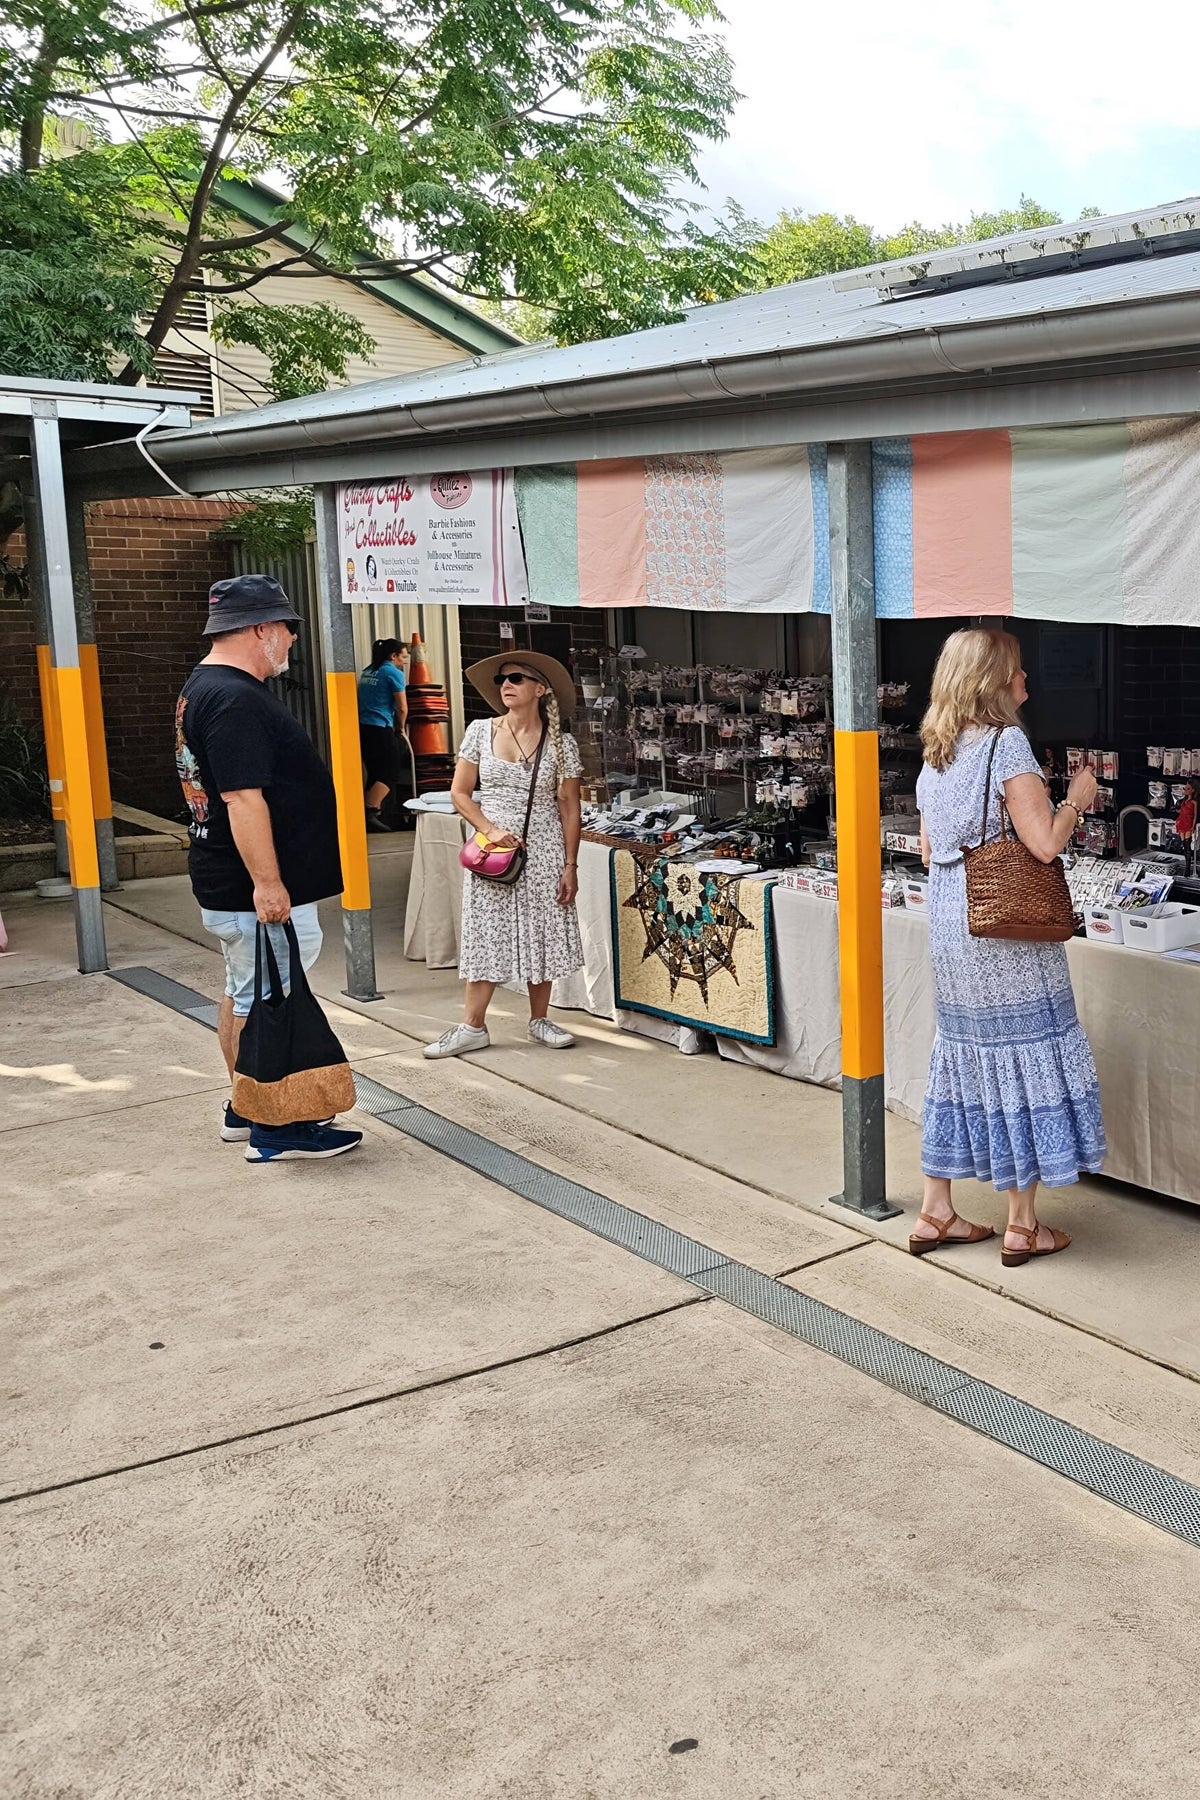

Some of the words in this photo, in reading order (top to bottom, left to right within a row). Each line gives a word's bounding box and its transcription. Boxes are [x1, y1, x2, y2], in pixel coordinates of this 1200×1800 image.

[344, 480, 375, 517] Quirky
[376, 476, 415, 514] Crafts
[428, 518, 450, 529] Barbie
[450, 517, 476, 528] Fashions
[355, 517, 418, 549] Collectibles
[431, 530, 438, 540] &
[439, 529, 473, 540] Accessories
[440, 561, 474, 571] Accessories
[395, 578, 417, 592] YouTube
